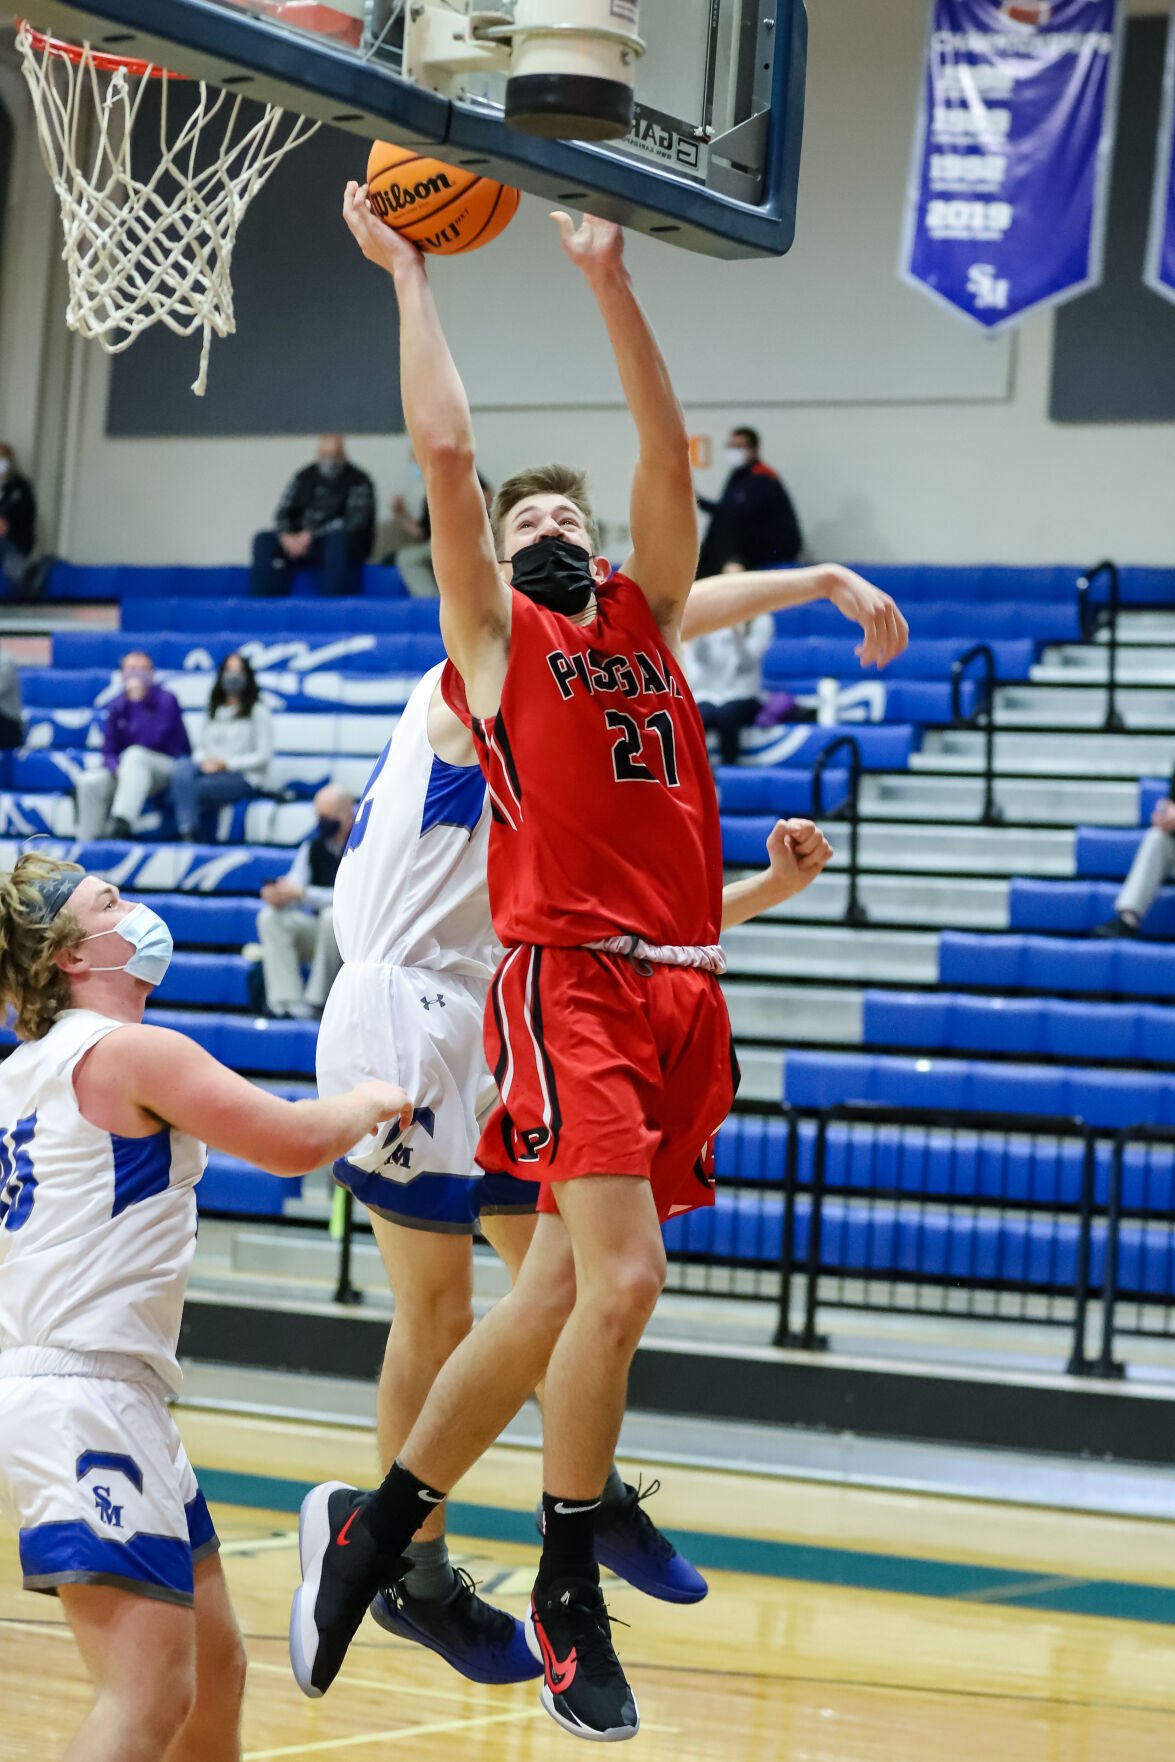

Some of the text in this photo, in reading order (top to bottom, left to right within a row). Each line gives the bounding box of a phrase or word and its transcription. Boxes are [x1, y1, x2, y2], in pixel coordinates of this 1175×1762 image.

[369, 173, 452, 218] Wilson
[604, 709, 680, 787] 21
[383, 1141, 414, 1169] M
[92, 1485, 124, 1529] SM
